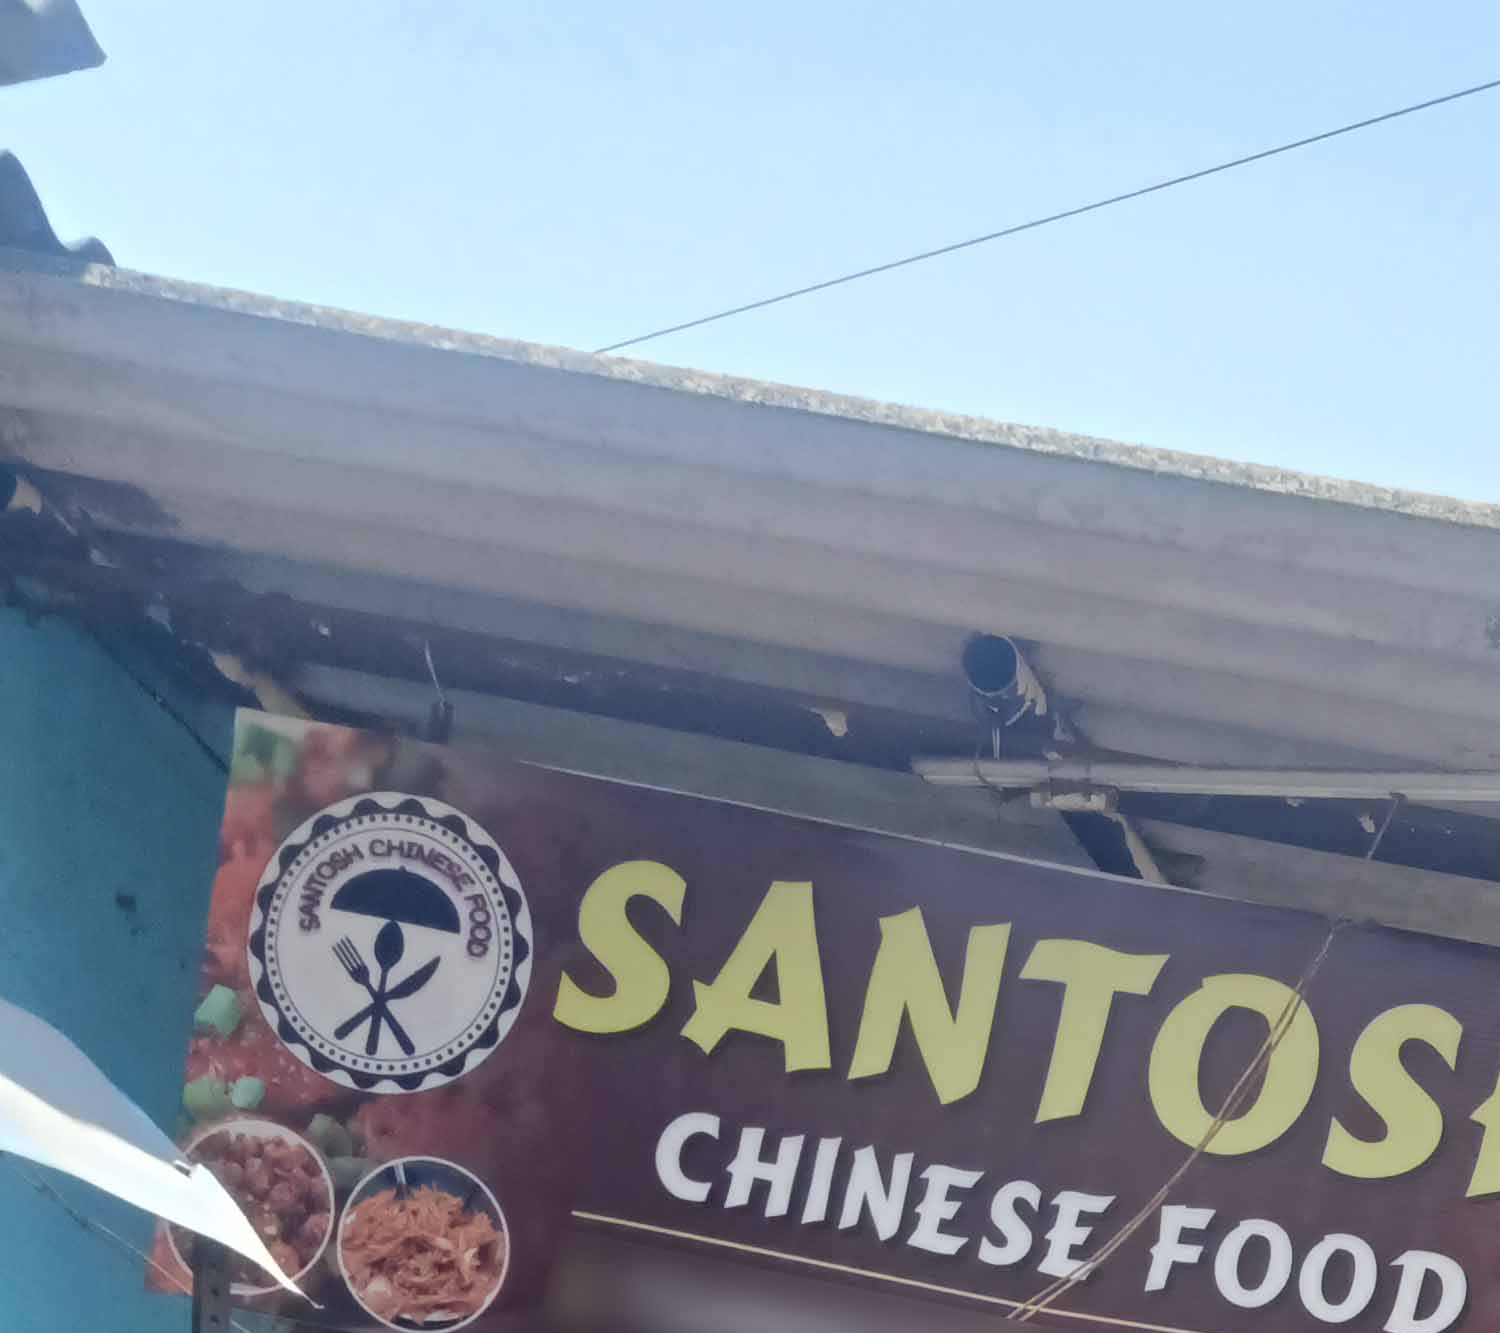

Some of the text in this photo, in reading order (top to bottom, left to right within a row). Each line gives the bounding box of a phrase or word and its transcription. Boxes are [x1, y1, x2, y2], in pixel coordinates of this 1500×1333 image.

[298, 838, 493, 959] SANTOSH CHINESE FOOD
[655, 1111, 1117, 1279] CHINESE
